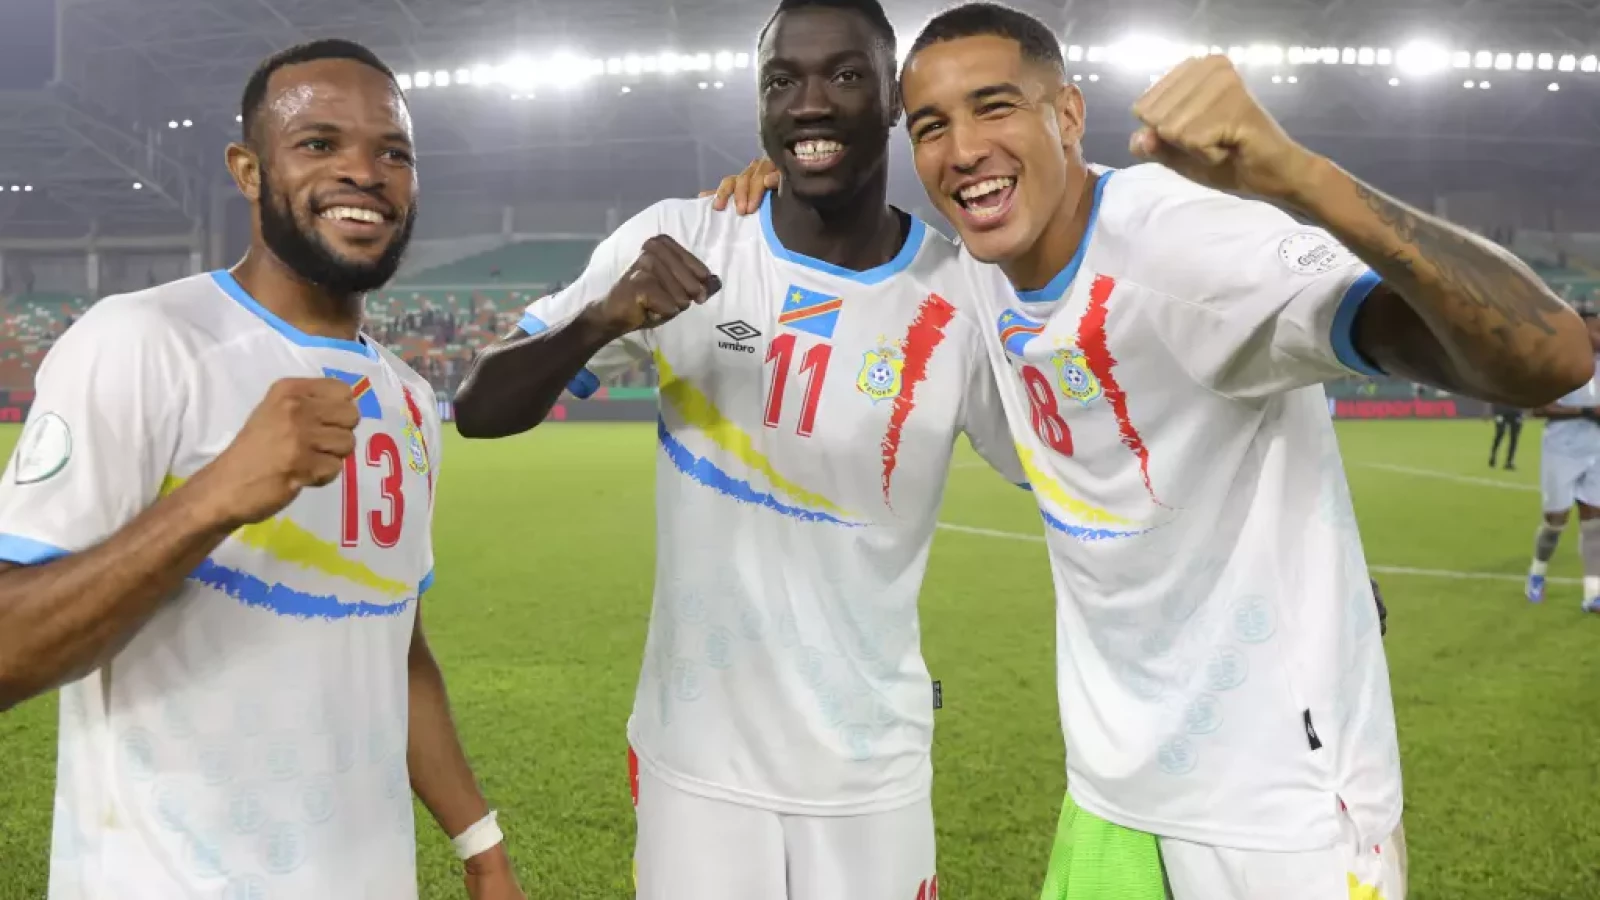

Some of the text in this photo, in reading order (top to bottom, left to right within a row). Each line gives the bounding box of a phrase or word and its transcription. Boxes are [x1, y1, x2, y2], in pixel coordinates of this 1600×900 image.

[718, 340, 755, 354] umbro
[764, 333, 832, 437] 11
[341, 432, 406, 548] 13
